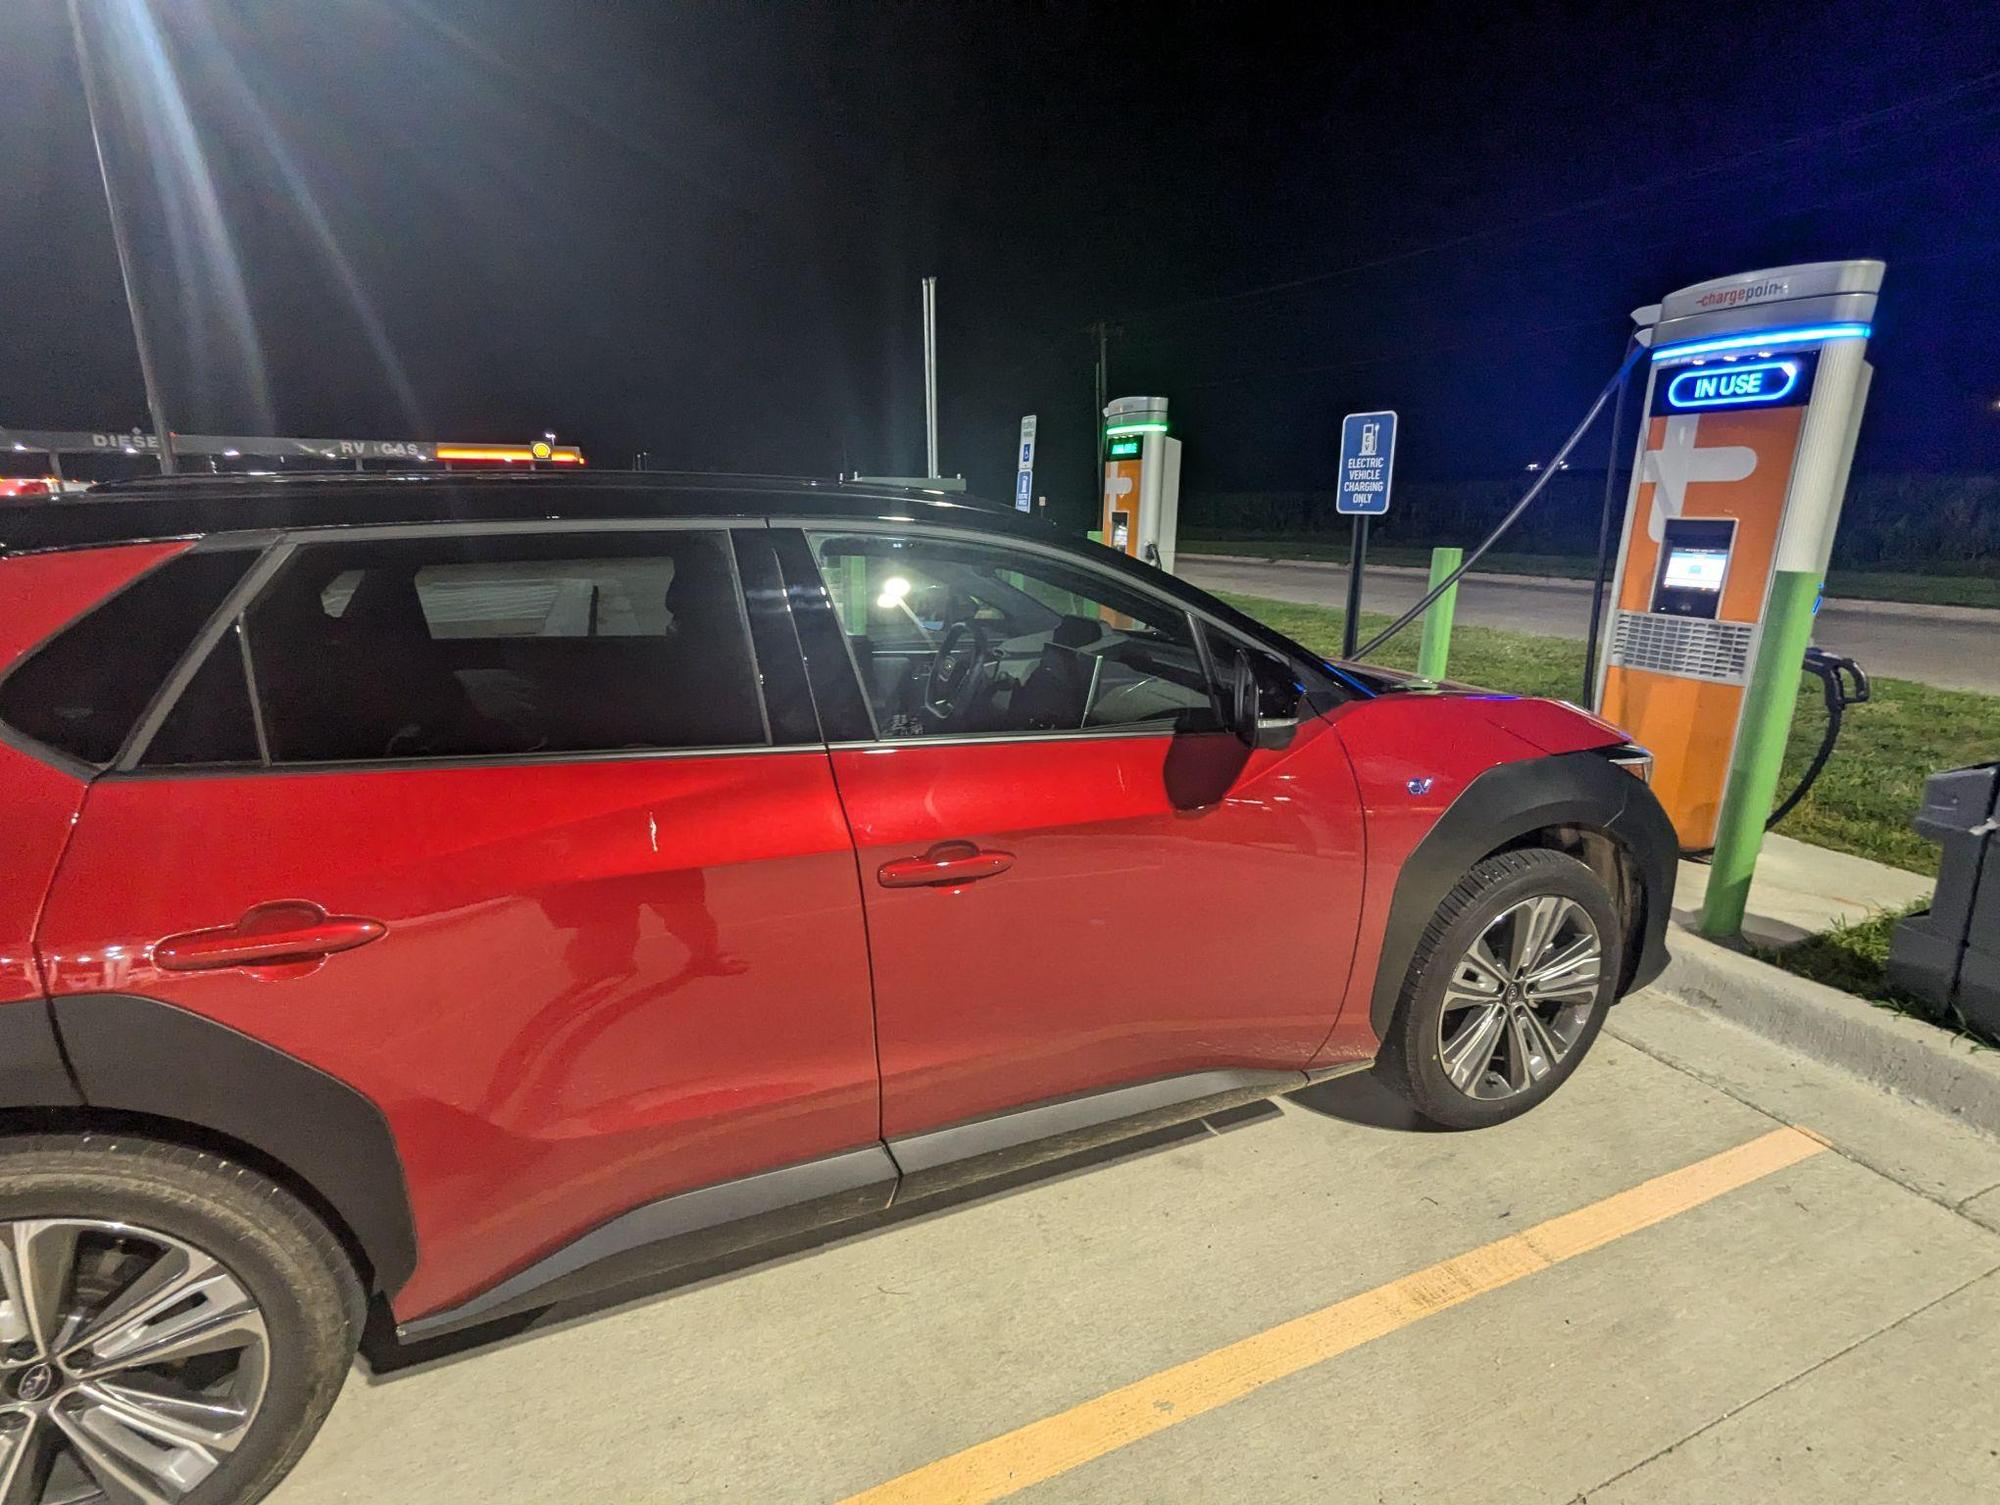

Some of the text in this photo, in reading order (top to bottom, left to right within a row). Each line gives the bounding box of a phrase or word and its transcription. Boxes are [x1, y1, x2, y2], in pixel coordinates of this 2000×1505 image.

[1694, 373, 1763, 398] IN USE
[92, 434, 161, 448] DIESE
[341, 442, 419, 457] RV GAS
[1348, 457, 1384, 468] ELECTRIC
[1349, 469, 1380, 480] VEHICLE
[1343, 481, 1384, 492] CHARGING
[1352, 493, 1373, 503] ONLY
